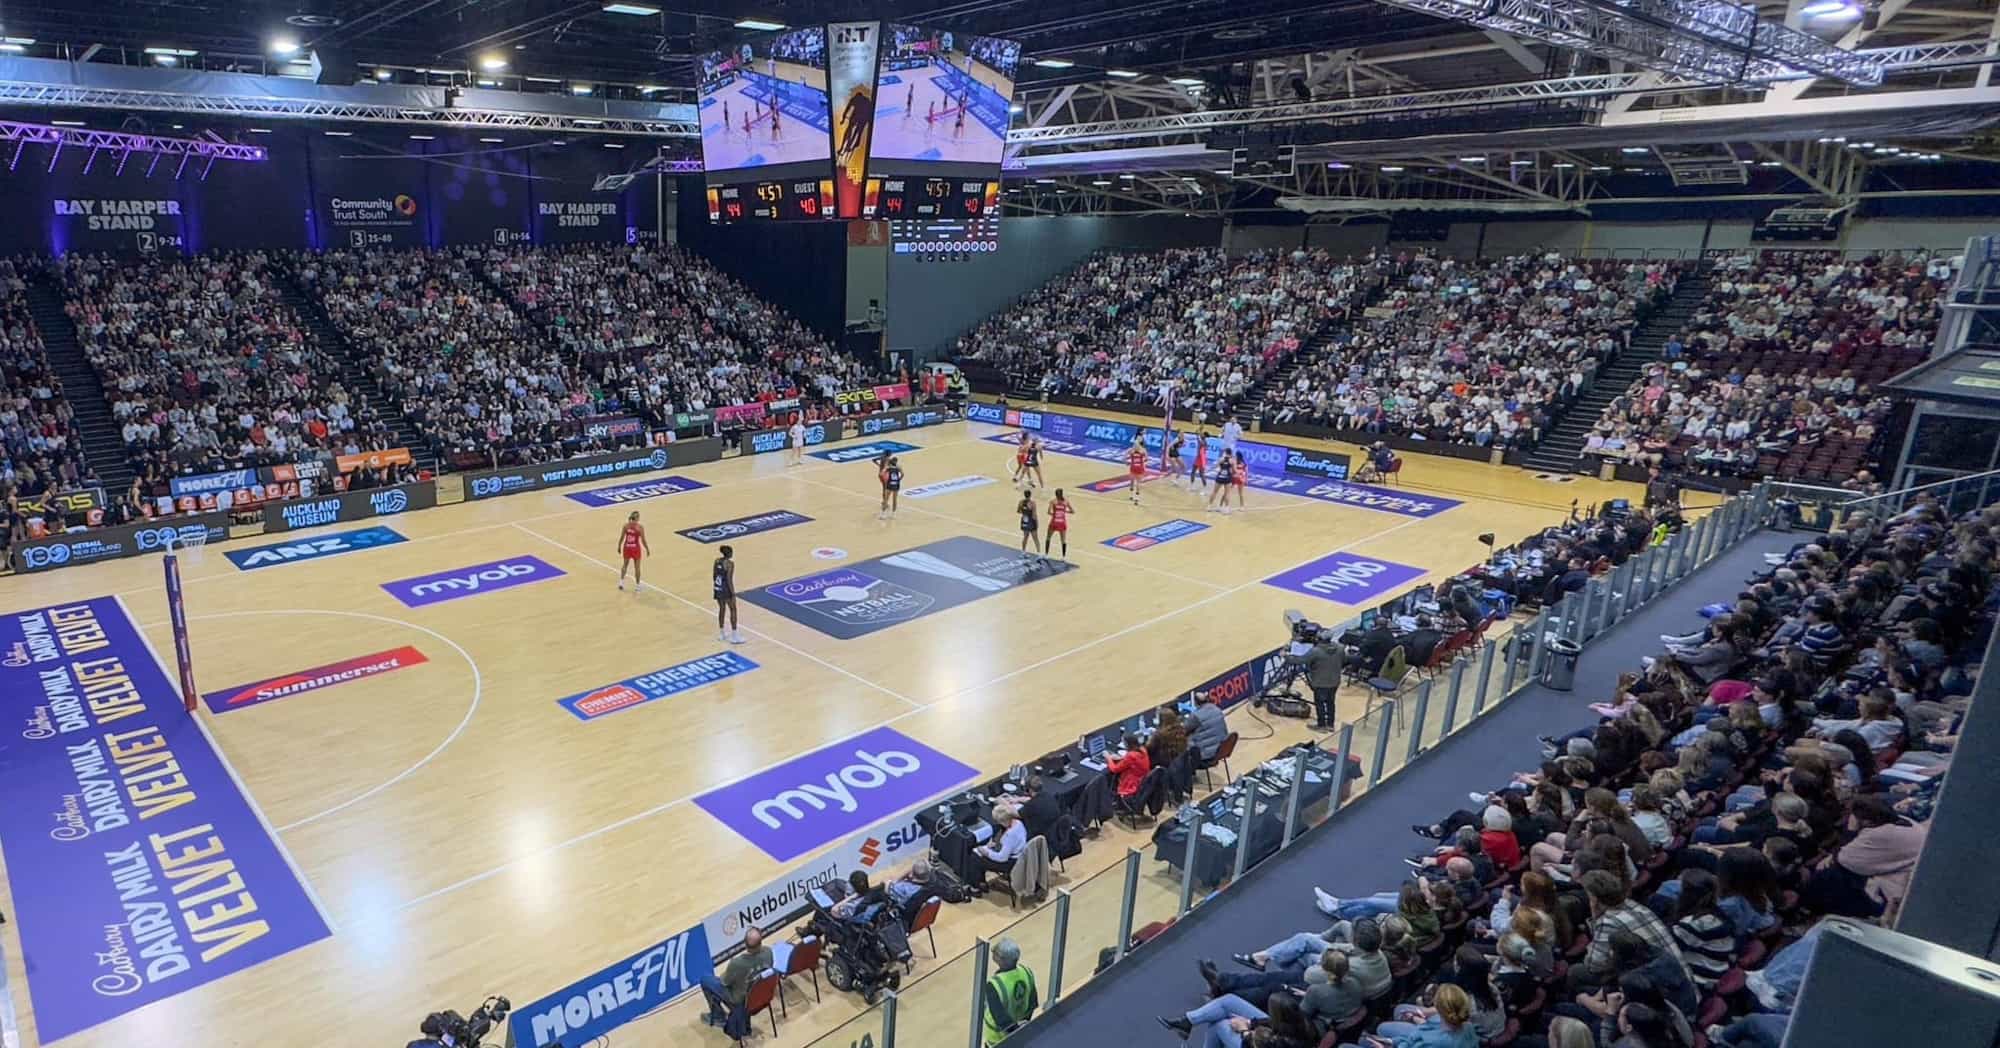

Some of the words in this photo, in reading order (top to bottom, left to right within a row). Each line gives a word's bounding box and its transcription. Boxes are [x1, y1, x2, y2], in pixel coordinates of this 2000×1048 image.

[757, 184, 783, 200] 4:57
[794, 182, 816, 194] GUEST
[885, 181, 905, 192] HOME
[926, 182, 951, 197] 4:57
[962, 183, 982, 193] GUEST
[54, 200, 96, 215] RAY
[101, 200, 181, 215] HARPER
[331, 198, 393, 211] Community
[333, 210, 358, 220] Trust
[359, 209, 388, 220] South
[539, 203, 565, 215] RAY
[567, 203, 617, 215] HARPER
[727, 203, 741, 217] 44
[771, 206, 777, 218] 3
[800, 198, 816, 214] 40
[887, 198, 902, 212] 44
[935, 204, 941, 215] 3
[965, 198, 978, 213] 40
[88, 216, 155, 230] STAND
[559, 215, 600, 227] STAND
[141, 234, 153, 249] 2
[836, 389, 876, 404] SKINS
[589, 424, 609, 436] sky
[609, 422, 638, 433] SPORT
[752, 431, 787, 445] AUCKLAND
[1085, 424, 1115, 439] ANZ
[542, 470, 566, 482] VISIT
[567, 467, 583, 479] 100
[584, 463, 614, 476] YEARS
[614, 461, 628, 471] OF
[629, 455, 653, 468] NETB
[1286, 454, 1348, 474] SilverFans
[282, 500, 341, 519] AUCKLAND
[288, 511, 337, 529] MUSEUM
[243, 537, 352, 567] ANZ
[410, 564, 536, 597] myob
[783, 573, 861, 597] Cadbury
[1302, 560, 1387, 594] myob
[833, 592, 914, 617] NETBALL
[48, 605, 110, 655] VELVET
[25, 634, 61, 662] DAIRY
[38, 666, 75, 696] MILK
[256, 657, 400, 701] Summerset
[634, 652, 738, 690] CHEMIST
[651, 663, 747, 697] WAREHOUSE
[72, 657, 147, 725] VELVET
[1208, 671, 1248, 705] SPORT
[582, 689, 634, 710] CHEMIST
[47, 695, 90, 733] DAIRY
[66, 738, 109, 783] MILK
[104, 726, 197, 820] VELVET
[751, 749, 921, 830] myob
[80, 779, 131, 833] DAIRY
[50, 793, 91, 841] Cadbury
[104, 841, 159, 901] MILK
[149, 823, 271, 963] VELVET
[738, 863, 839, 929] NetballSmart
[123, 902, 191, 983] DAIRY
[92, 922, 143, 996] Cadbury
